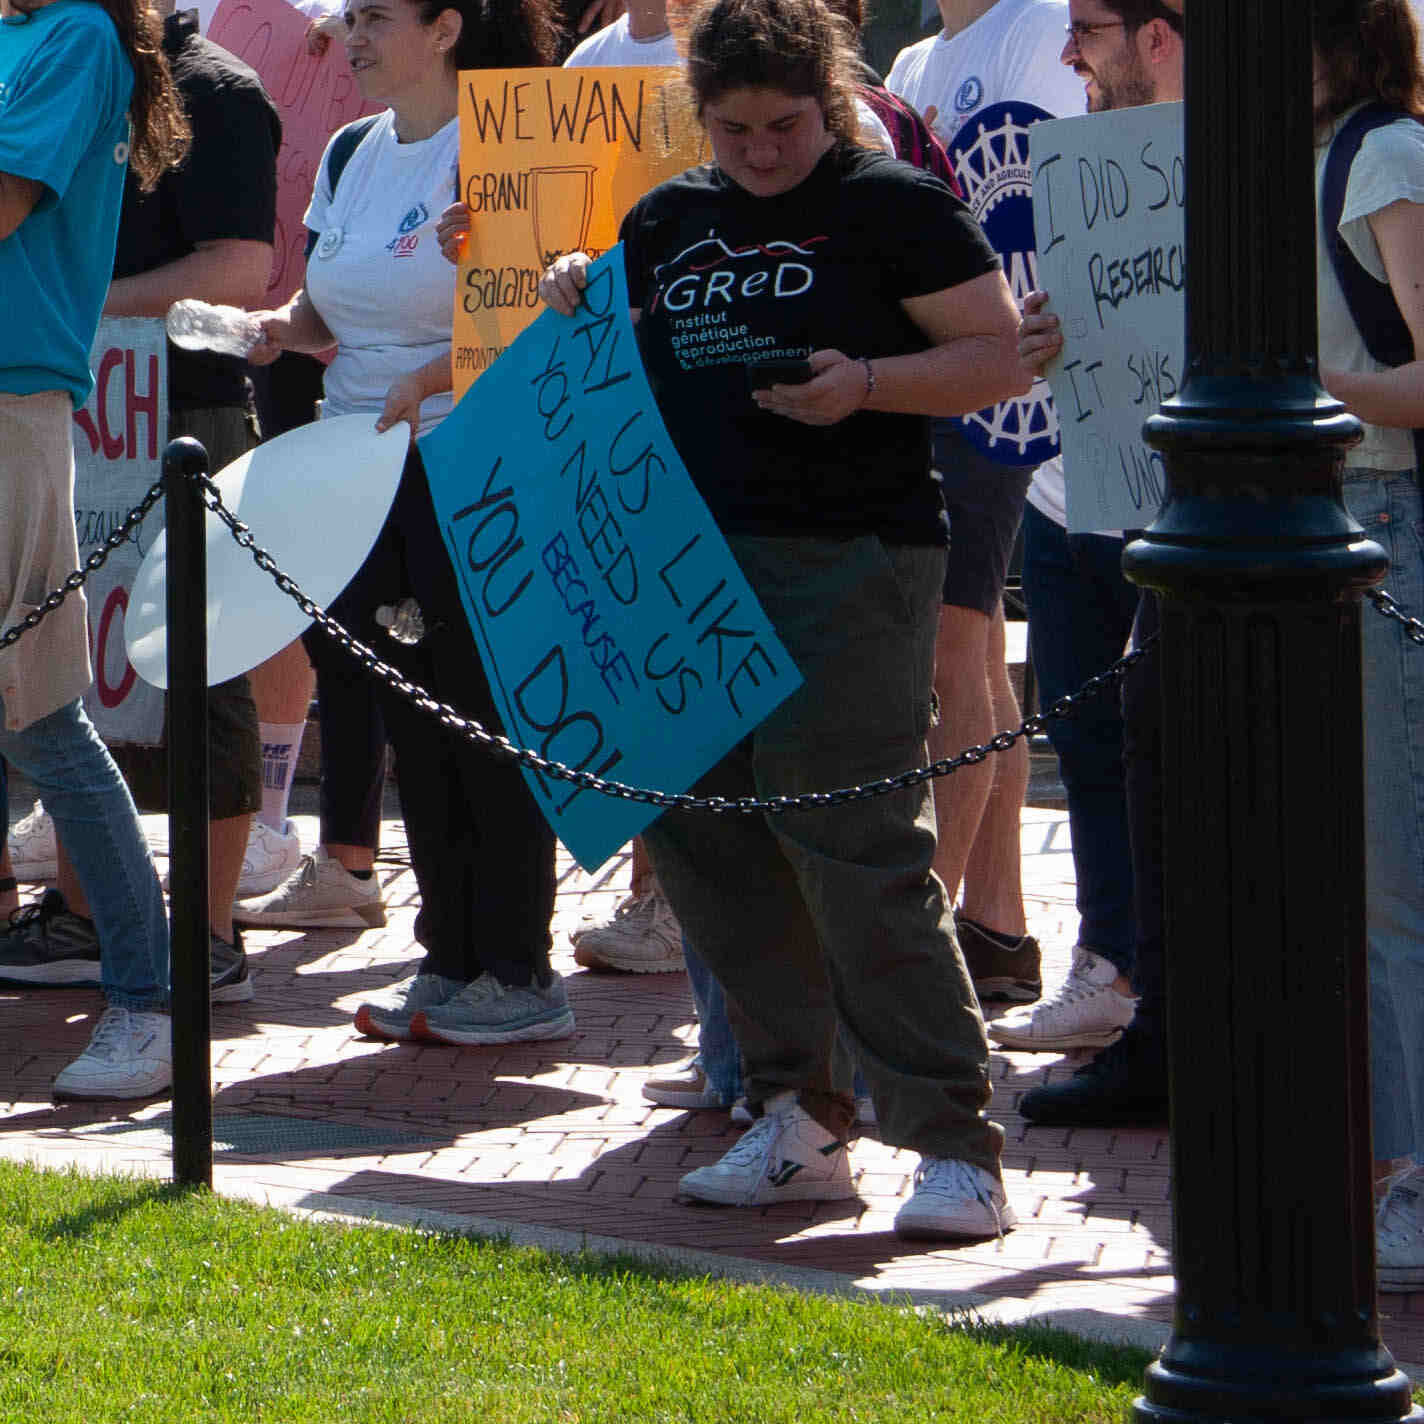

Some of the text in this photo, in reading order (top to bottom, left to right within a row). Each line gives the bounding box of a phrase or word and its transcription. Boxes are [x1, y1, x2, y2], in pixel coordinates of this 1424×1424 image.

[468, 79, 536, 145] WE
[466, 171, 531, 213] GRANT
[1035, 141, 1186, 255] I DID SO
[650, 262, 814, 315] iGReD
[670, 311, 728, 330] institut
[674, 334, 777, 360] reproduction
[1064, 359, 1104, 423] IT
[452, 455, 535, 619] YOU
[531, 335, 704, 716] YOU NEED US
[608, 410, 668, 515] US
[658, 533, 779, 719] LIKE
[541, 530, 641, 706] BECAUSE
